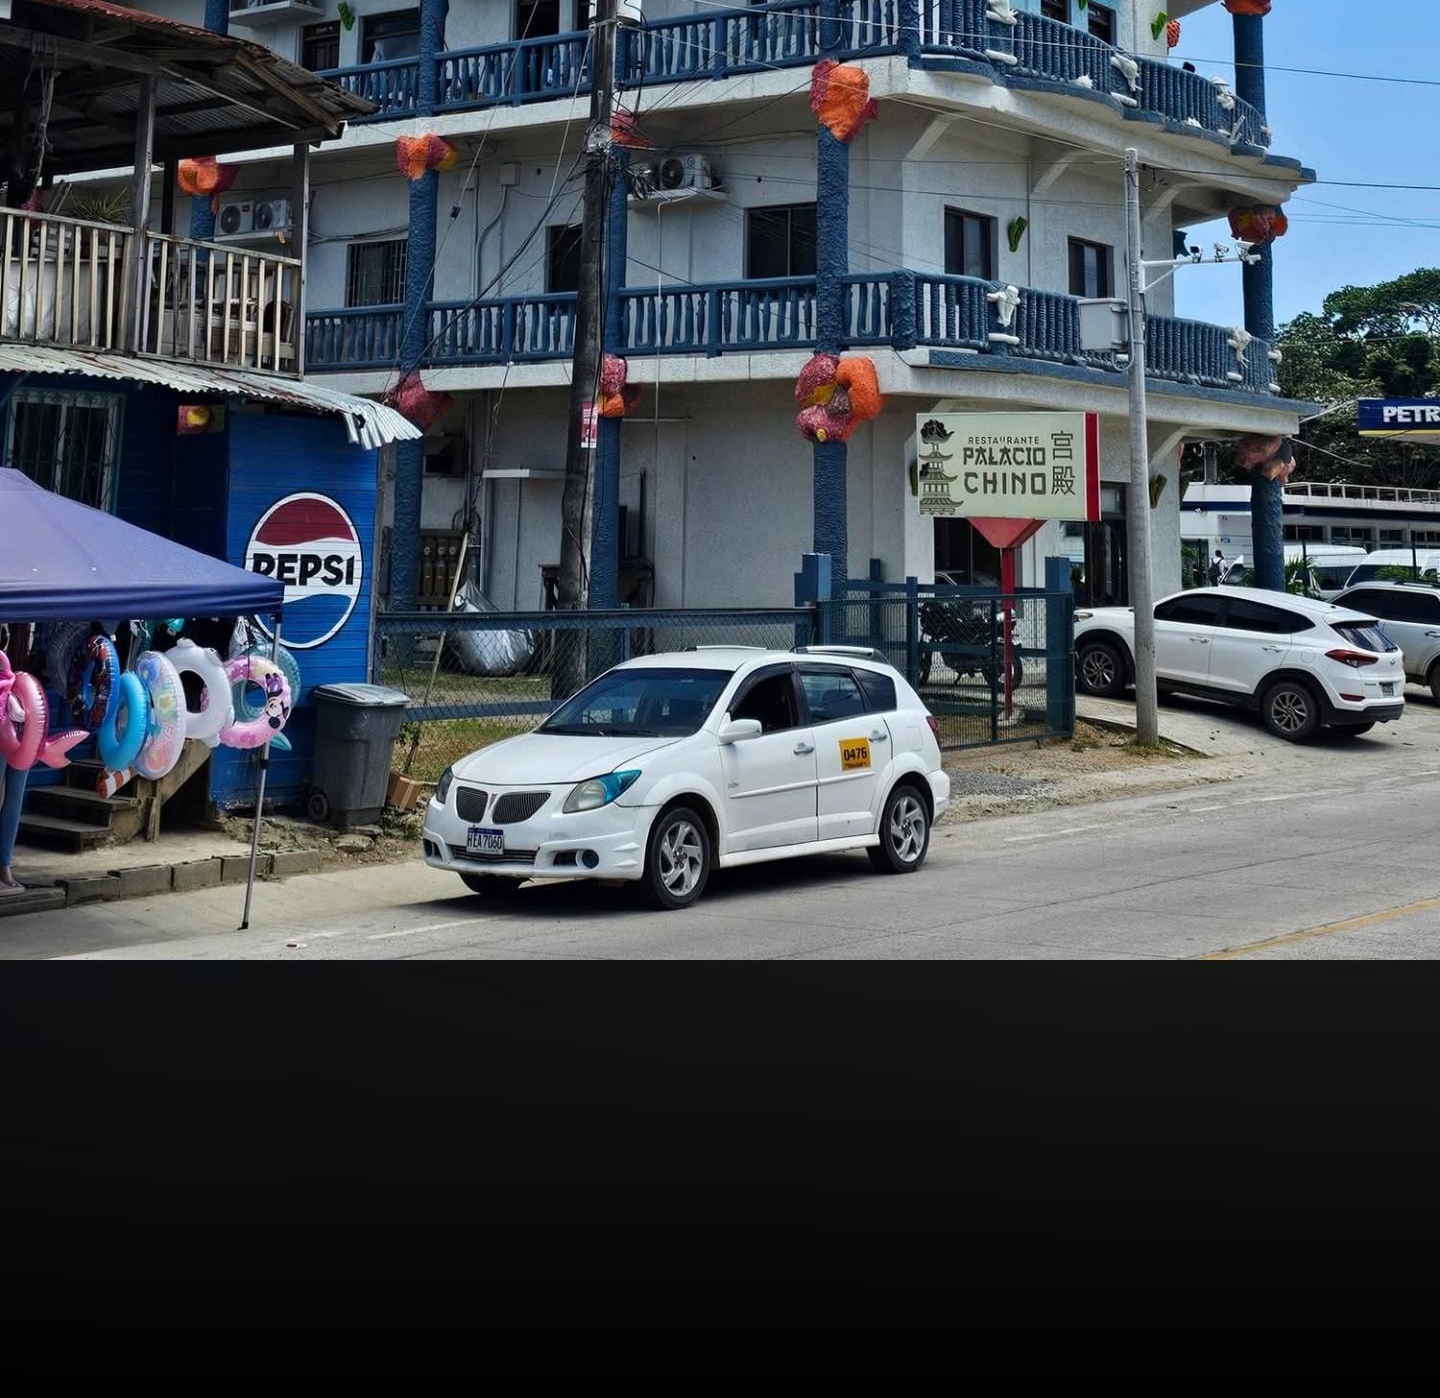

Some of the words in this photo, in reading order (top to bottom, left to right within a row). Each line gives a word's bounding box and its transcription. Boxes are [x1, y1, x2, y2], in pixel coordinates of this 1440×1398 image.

[968, 436, 1040, 445] RESTAURANTE
[963, 446, 1046, 466] PALACIO
[964, 472, 1046, 495] CHINO
[252, 553, 355, 587] PEPSI
[844, 747, 867, 761] 0476
